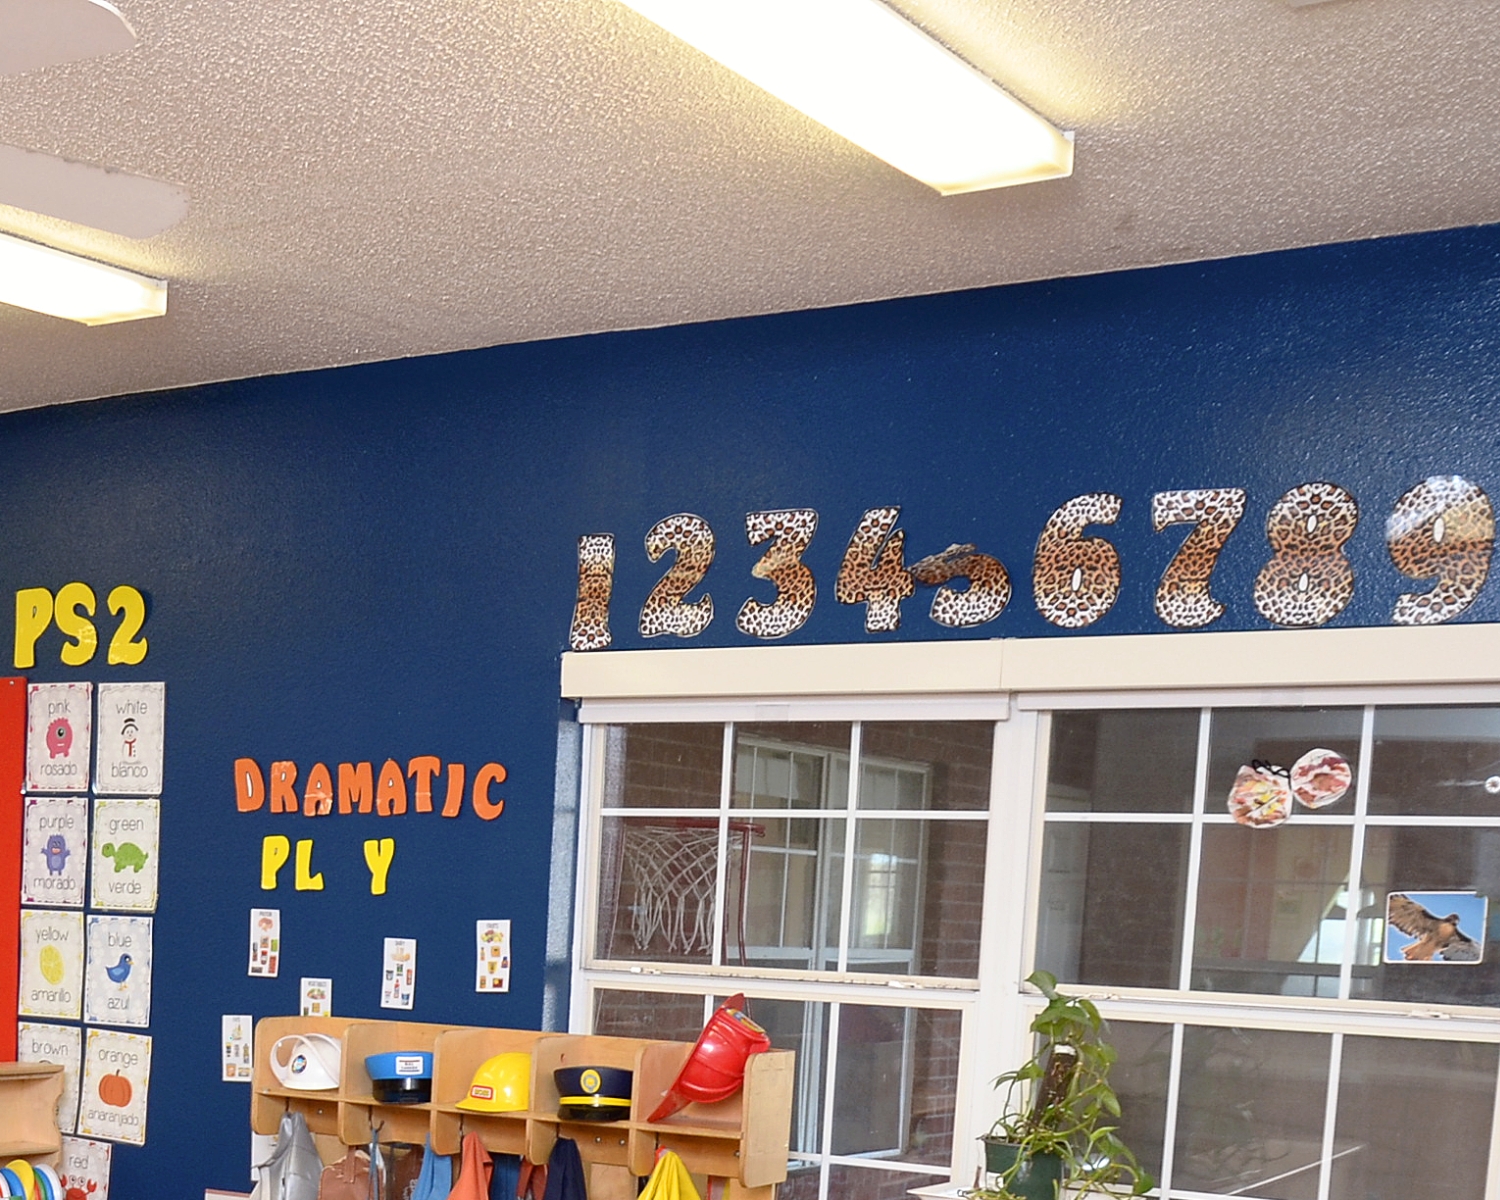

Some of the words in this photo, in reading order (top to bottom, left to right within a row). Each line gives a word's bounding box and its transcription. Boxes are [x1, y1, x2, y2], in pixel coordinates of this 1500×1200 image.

[571, 533, 615, 652] 1
[639, 512, 715, 637] 2
[735, 507, 819, 638] 3
[836, 506, 914, 632] 4
[1032, 492, 1123, 626] 6
[1153, 487, 1247, 629] 7
[1254, 481, 1359, 627] 8
[1386, 475, 1496, 626] 9
[13, 581, 149, 669] PS2
[48, 699, 70, 718] pink
[116, 700, 148, 714] white
[40, 761, 77, 776] rosado
[111, 762, 148, 778] blanco
[233, 755, 507, 820] DRAMATIC
[39, 815, 74, 831] purple
[109, 818, 144, 835] green
[33, 877, 76, 891] morado
[108, 879, 141, 894] verde
[35, 927, 69, 944] yellow
[108, 933, 132, 947] blue
[31, 988, 71, 1003] amarillo
[107, 996, 130, 1010] azul
[32, 1038, 69, 1055] brown
[98, 1049, 139, 1067] orange
[87, 1109, 139, 1127] anaranjado
[68, 1154, 89, 1169] red
